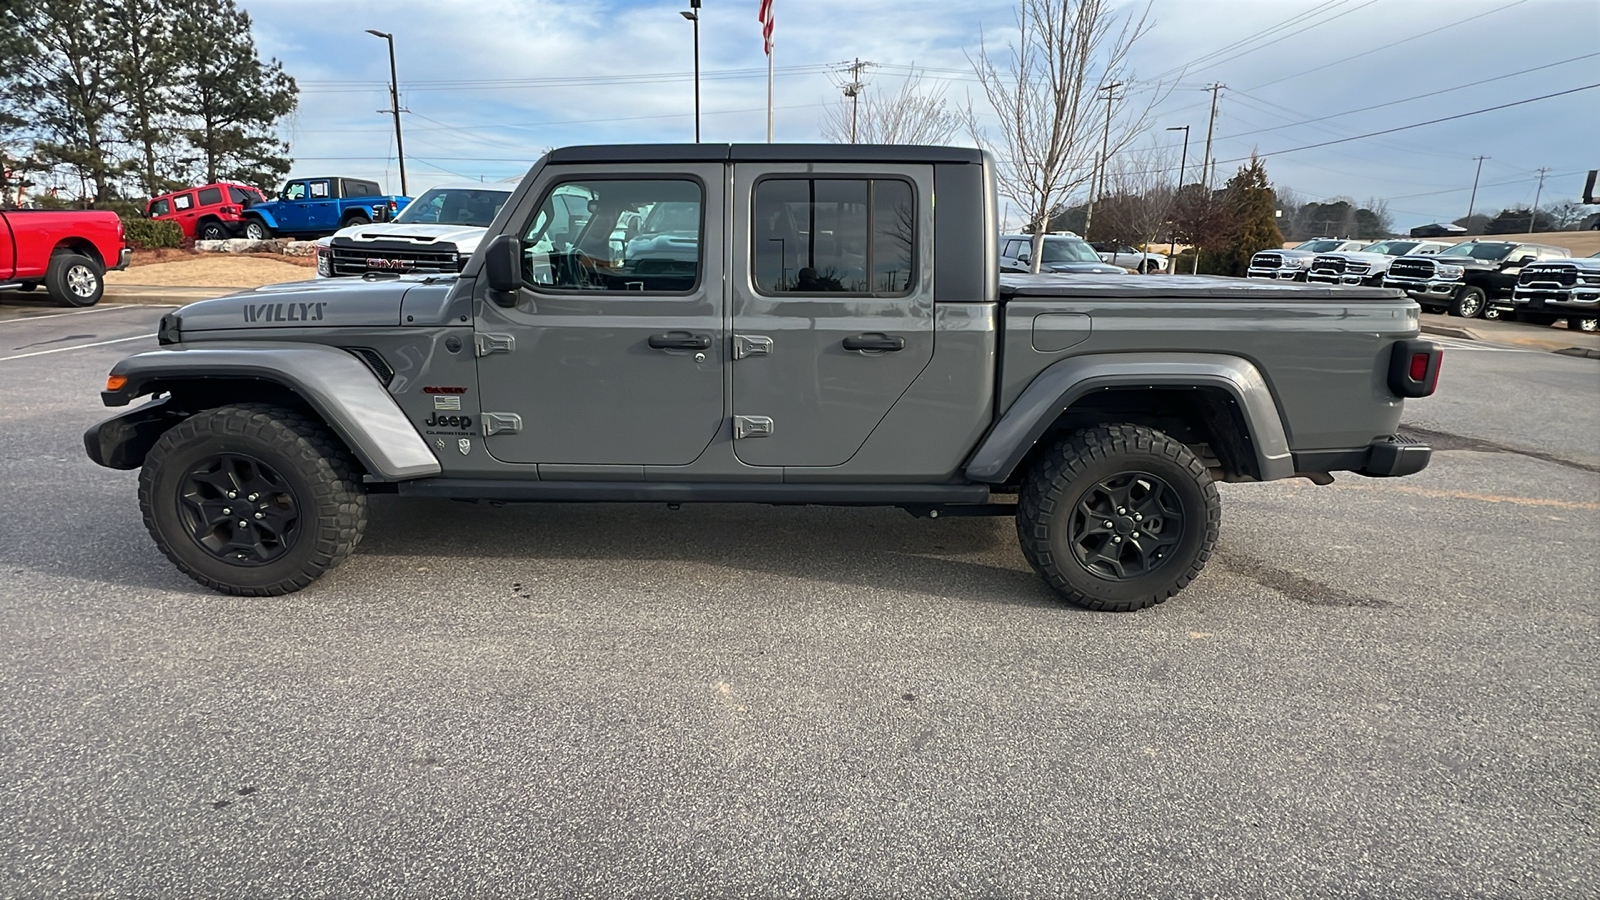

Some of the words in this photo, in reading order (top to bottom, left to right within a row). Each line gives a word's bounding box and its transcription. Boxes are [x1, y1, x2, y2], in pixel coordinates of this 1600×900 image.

[366, 258, 415, 269] GMC
[243, 302, 327, 322] WILLYS
[425, 411, 472, 430] Jeep
